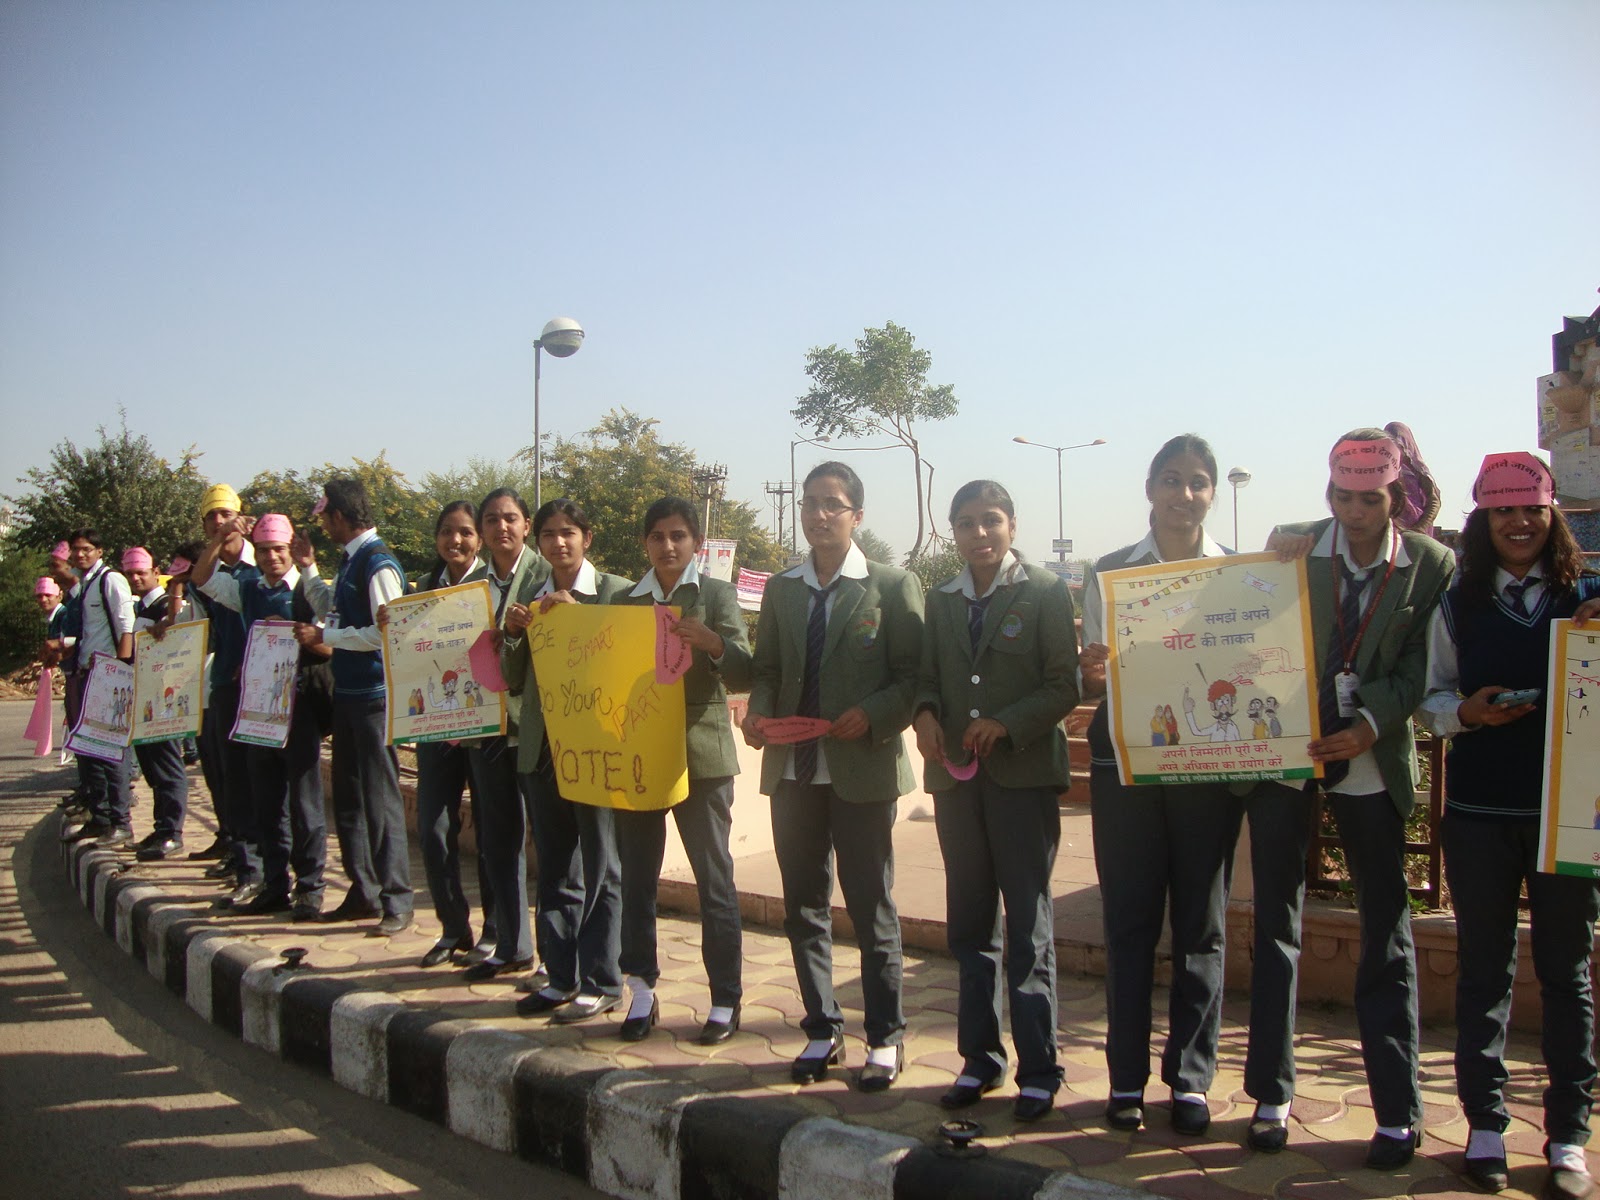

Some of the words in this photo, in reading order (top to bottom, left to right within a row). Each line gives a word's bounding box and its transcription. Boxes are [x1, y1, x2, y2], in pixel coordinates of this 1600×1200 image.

[1204, 608, 1237, 624] समझें
[1242, 605, 1270, 620] अपने
[415, 637, 433, 652] वोट
[531, 623, 555, 654] BE
[1162, 628, 1196, 650] वोट
[1200, 632, 1217, 647] की
[1220, 632, 1256, 646] ताकत
[561, 679, 613, 717] YOUR
[612, 681, 661, 743] PART
[1162, 747, 1187, 759] अपनी
[1190, 744, 1232, 758] जिम्मेदारी
[1235, 742, 1251, 758] पूरी
[1157, 760, 1179, 772] अपने
[1183, 760, 1219, 771] अधिकार
[1222, 760, 1235, 769] का
[1239, 757, 1265, 769] प्रयोग
[1268, 754, 1284, 767] करें
